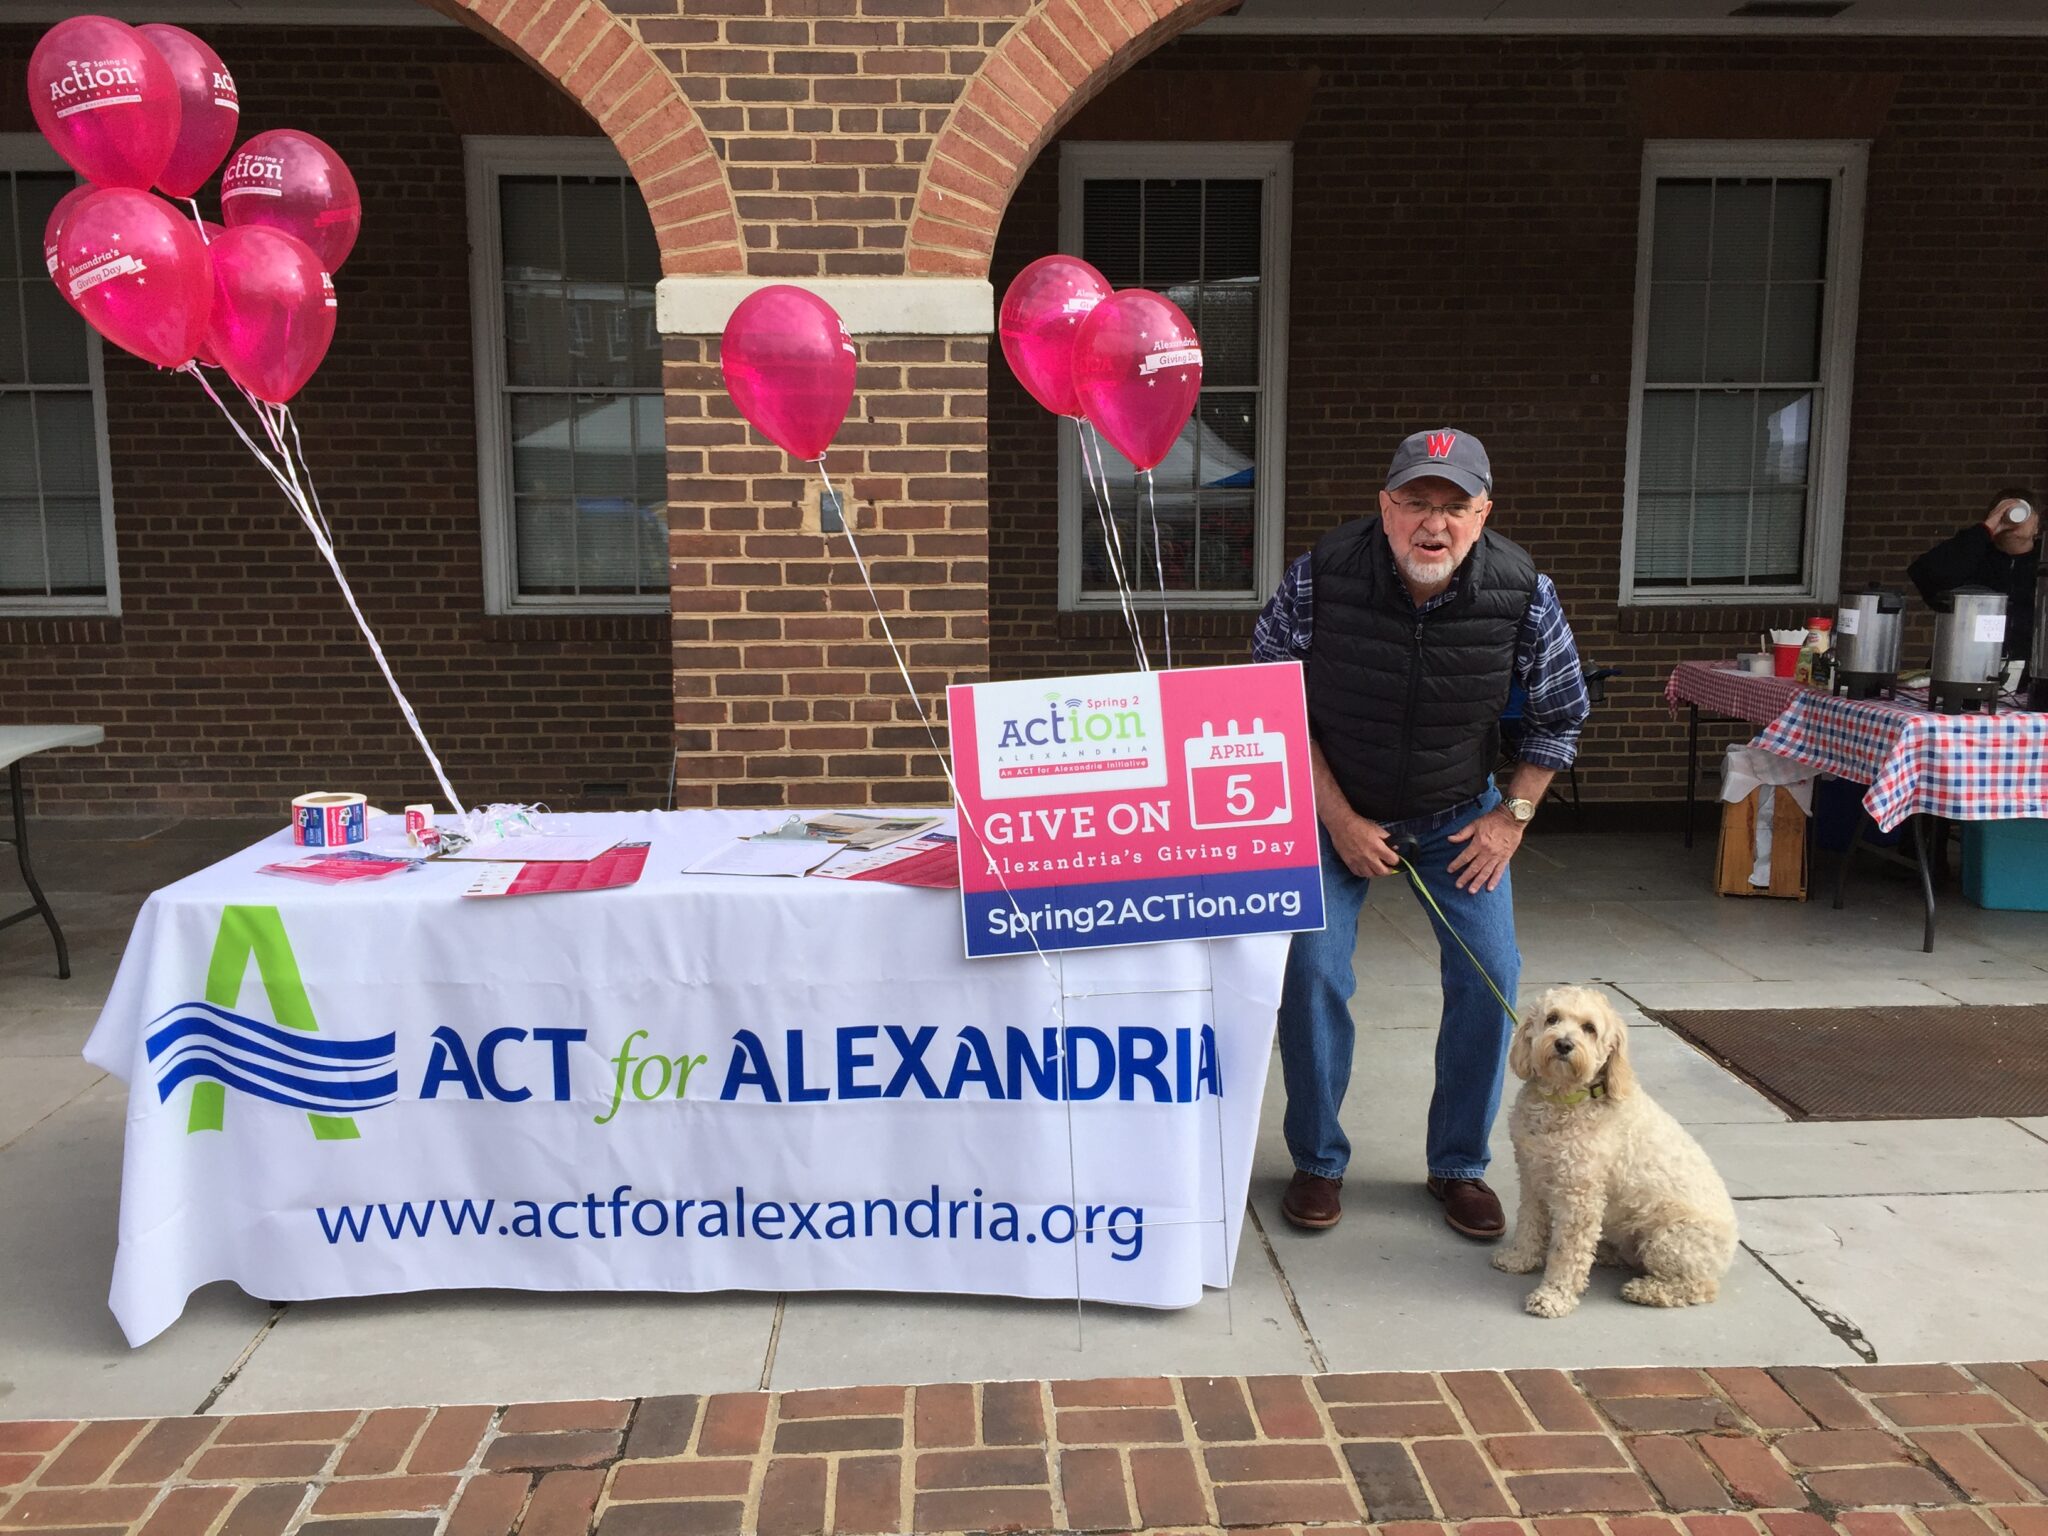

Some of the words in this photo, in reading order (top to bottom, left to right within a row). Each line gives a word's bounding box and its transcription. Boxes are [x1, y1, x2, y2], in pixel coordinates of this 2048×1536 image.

[102, 264, 122, 279] Day
[1426, 432, 1457, 458] W
[1087, 698, 1127, 710] Spring
[1132, 696, 1139, 705] 2
[1001, 769, 1012, 777] An
[1016, 768, 1034, 776] ACT
[1037, 766, 1050, 775] for
[1054, 762, 1103, 773] Alexandria
[1106, 759, 1146, 769] Initiative
[1209, 742, 1264, 760] APRIL
[1226, 773, 1255, 816] 5
[984, 806, 1096, 845] GIVE
[1107, 800, 1171, 836] ON
[985, 849, 1143, 875] Alexandria's
[1158, 843, 1238, 862] Giving
[1252, 839, 1296, 857] Day
[988, 890, 1301, 939] Spring2ACTion.org
[419, 1025, 588, 1103] ACT
[593, 1029, 708, 1125] for
[720, 1024, 1223, 1104] ALEXANDRIA
[316, 1184, 1143, 1262] www.actforalexandria.org
